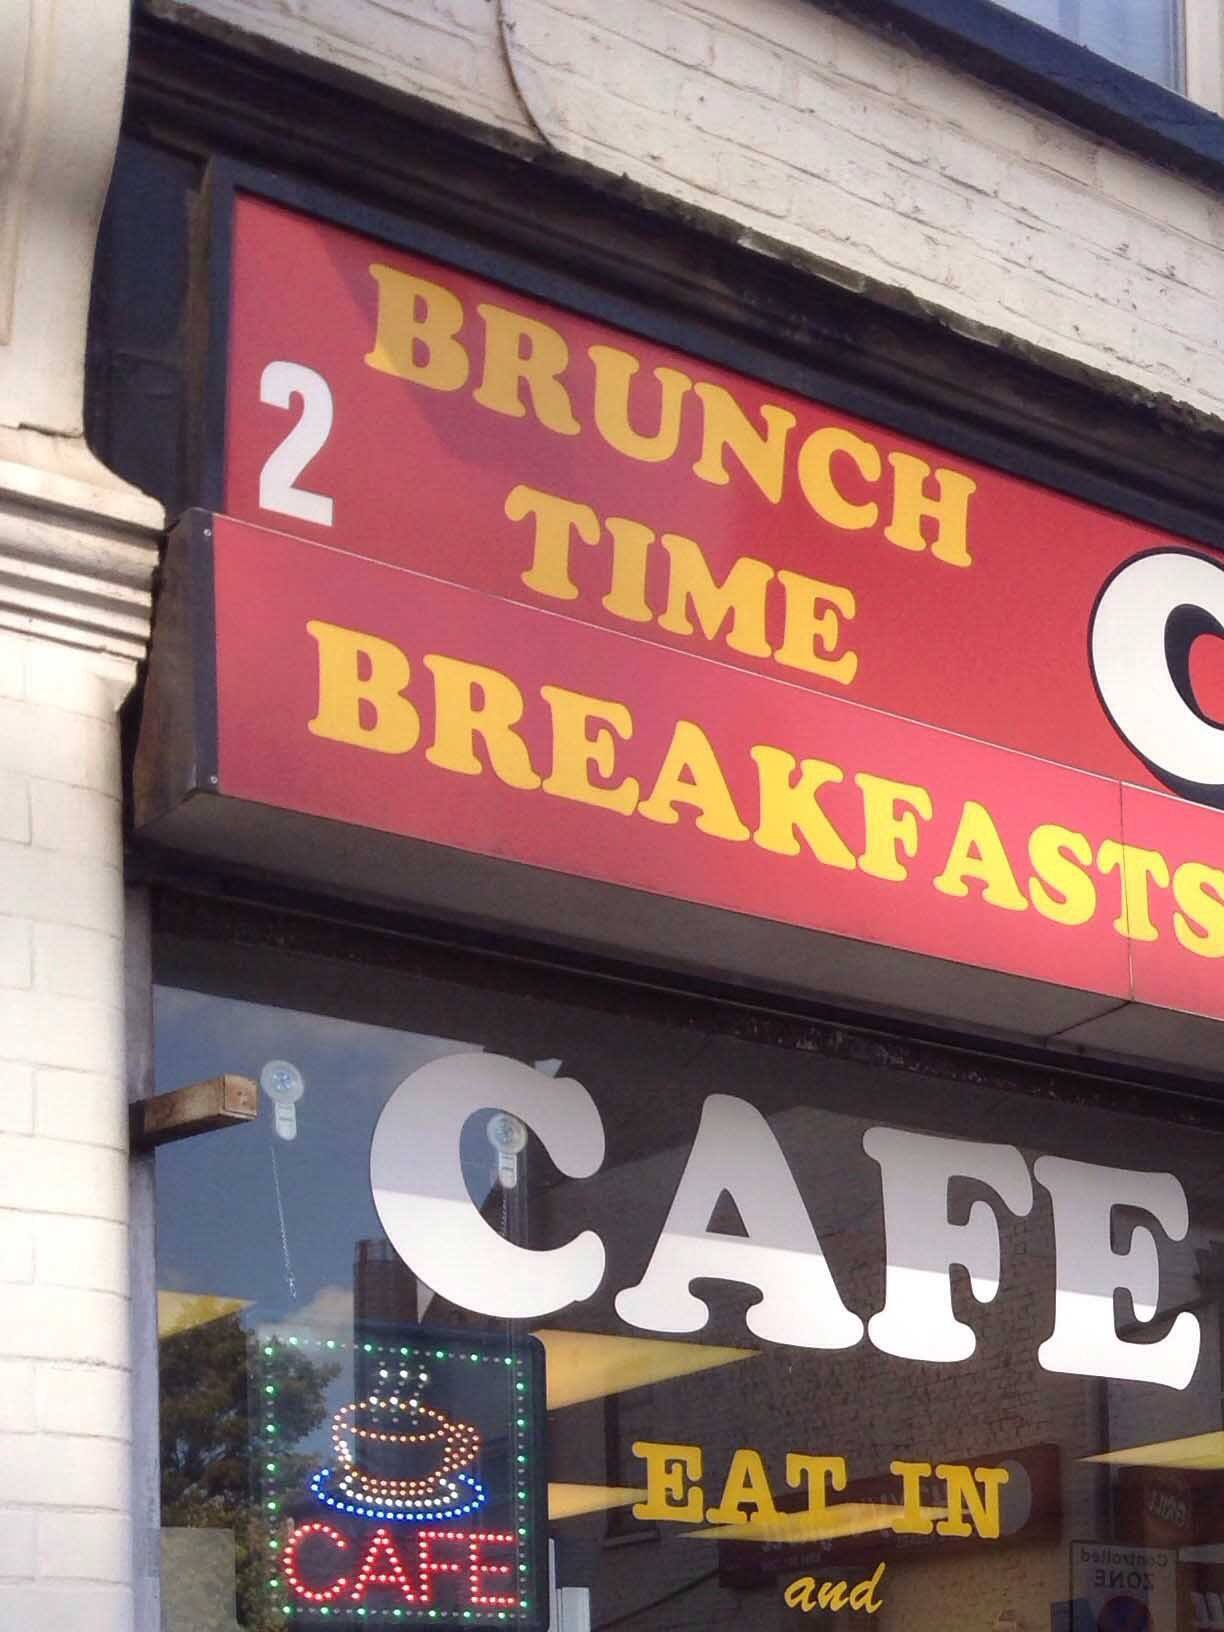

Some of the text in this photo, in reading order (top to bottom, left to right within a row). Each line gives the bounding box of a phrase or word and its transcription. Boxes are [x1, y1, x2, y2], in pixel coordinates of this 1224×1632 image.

[259, 360, 334, 527] 2
[364, 263, 976, 567] BRUNCH
[504, 485, 857, 685] TIME
[370, 1052, 1201, 1390] CAFE
[283, 1521, 516, 1607] CAFE
[632, 1440, 847, 1528] EAT
[889, 1460, 1009, 1539] IN
[784, 1561, 886, 1613] and
